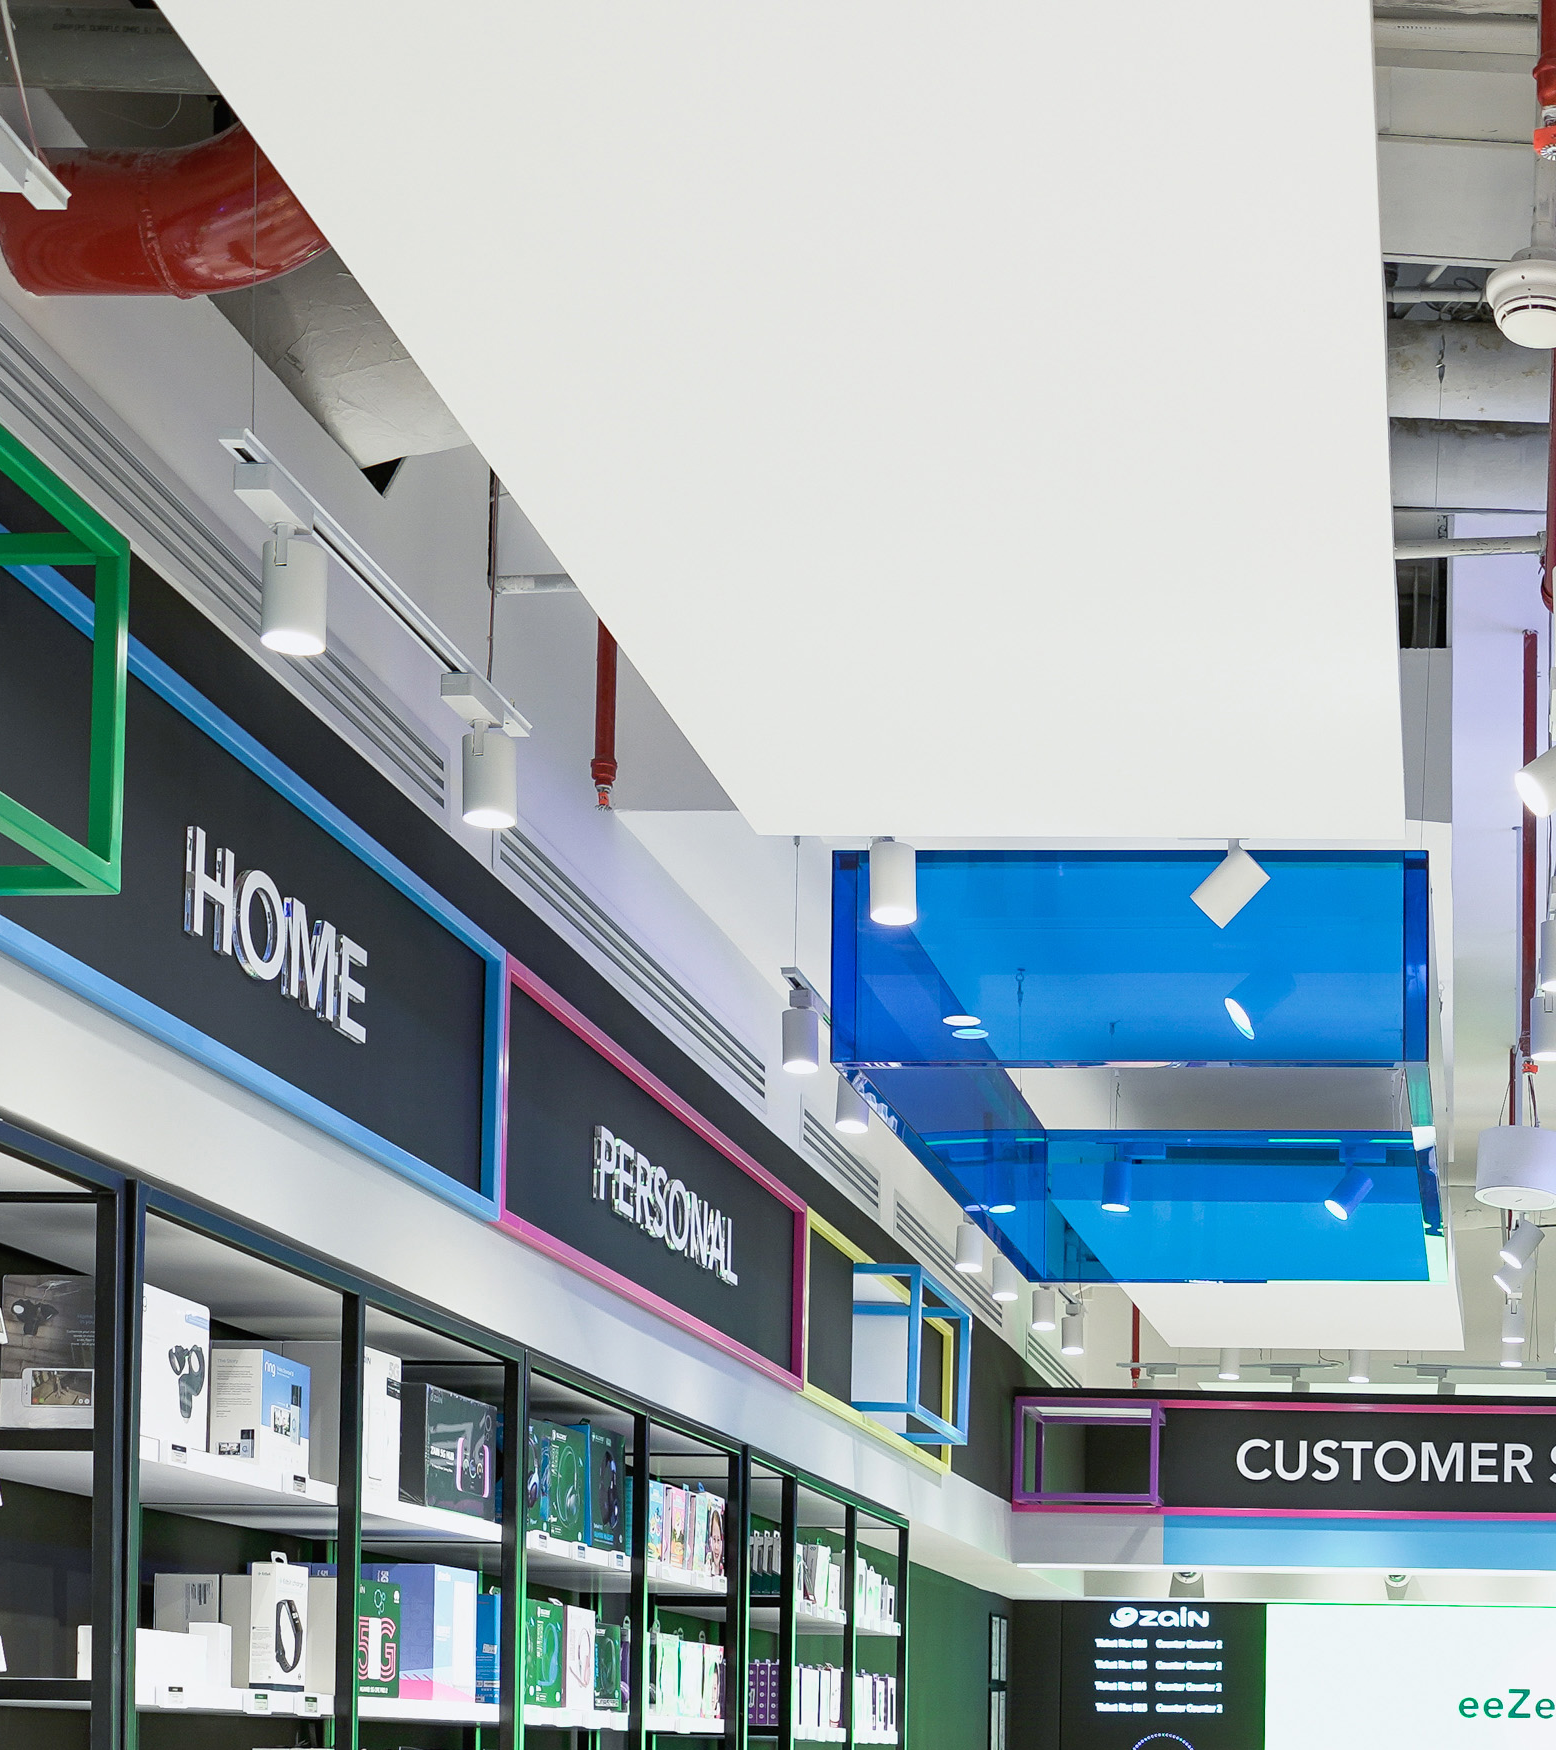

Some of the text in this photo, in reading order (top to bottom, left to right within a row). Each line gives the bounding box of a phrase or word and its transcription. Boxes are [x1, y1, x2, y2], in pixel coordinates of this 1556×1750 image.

[182, 824, 369, 1046] HOME
[592, 1124, 739, 1287] PERSONAL
[264, 1360, 277, 1377] ring
[1236, 1438, 1534, 1484] CUSTOMER
